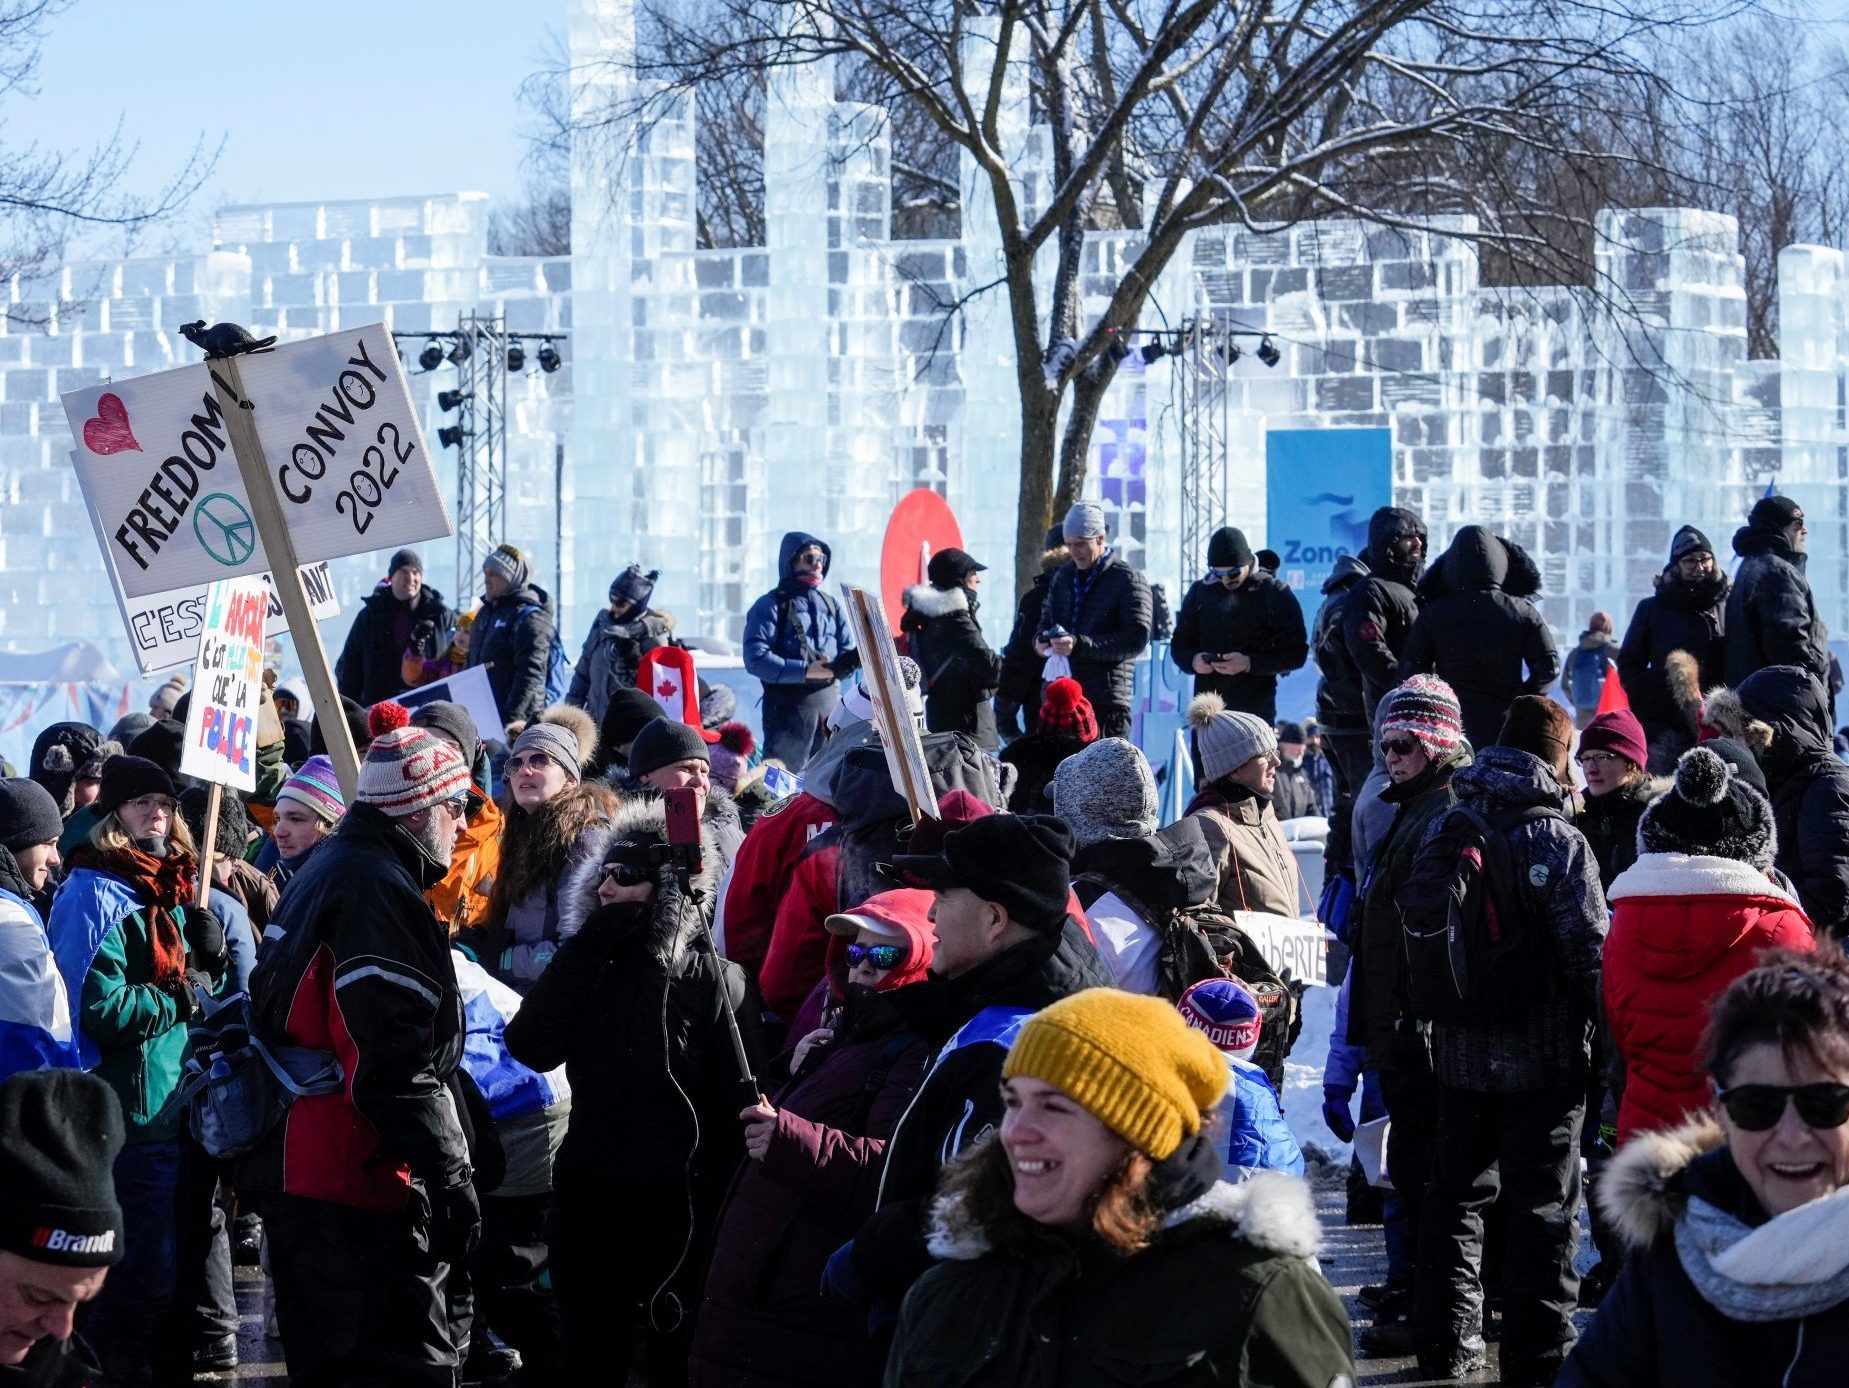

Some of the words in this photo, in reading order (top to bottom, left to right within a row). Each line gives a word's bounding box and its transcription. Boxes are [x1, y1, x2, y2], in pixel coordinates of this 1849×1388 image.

[279, 339, 387, 504] CONVOY
[336, 422, 415, 535] 2022
[199, 706, 253, 775] POLICE
[1180, 1005, 1255, 1046] CANADIENS
